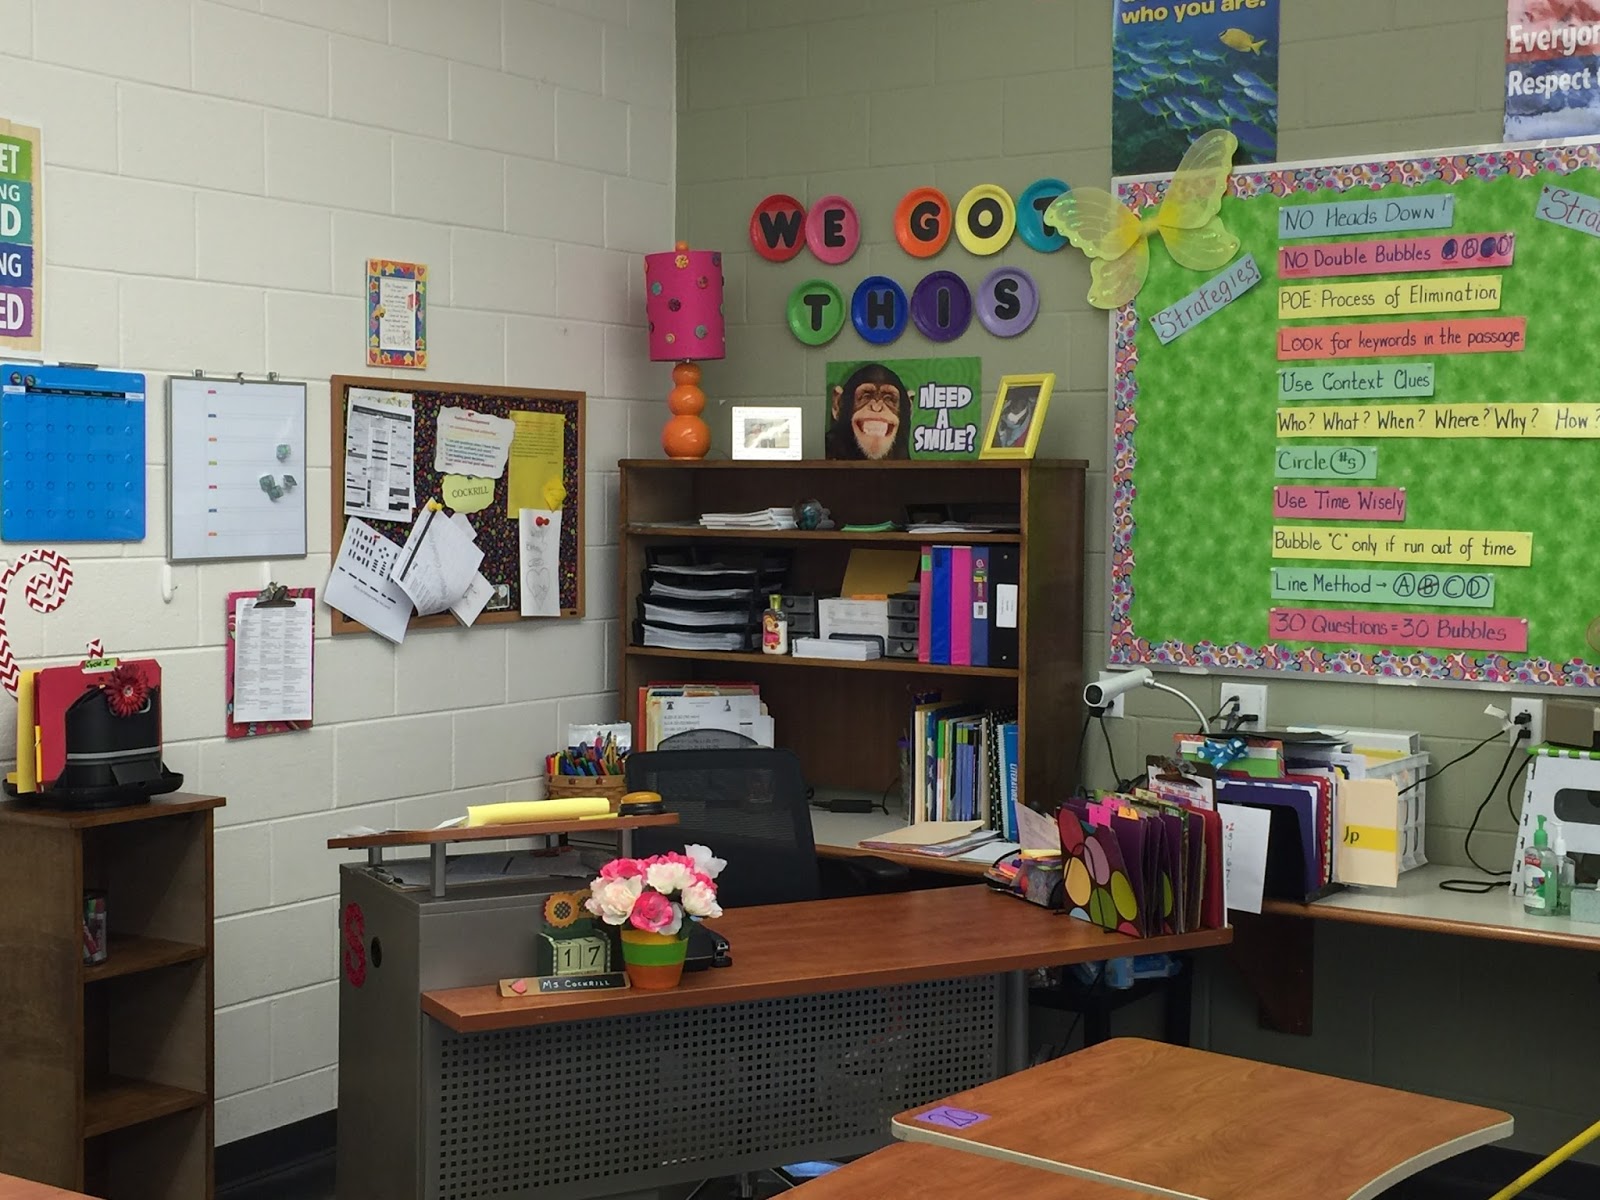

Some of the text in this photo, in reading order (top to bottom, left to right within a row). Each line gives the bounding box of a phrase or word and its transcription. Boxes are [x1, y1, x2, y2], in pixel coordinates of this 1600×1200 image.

[1121, 6, 1168, 24] who
[1173, 0, 1215, 23] you
[1508, 67, 1591, 100] Respect
[0, 203, 22, 237] D
[758, 208, 846, 250] WE
[1285, 209, 1314, 231] NO
[1326, 204, 1377, 228] Heads
[1284, 250, 1308, 269] NO
[1314, 244, 1368, 268] Double
[1375, 242, 1432, 264] Bubbles
[802, 277, 1021, 332] THIS
[1158, 259, 1256, 339] Strategies
[1321, 289, 1375, 309] Process
[1385, 285, 1401, 308] of
[1409, 282, 1498, 304] Elimination
[1329, 331, 1352, 356] for
[1358, 329, 1417, 352] keywords
[1424, 330, 1434, 346] in
[1439, 327, 1461, 345] the
[1282, 369, 1431, 393] Use Context Clues
[919, 382, 973, 409] NEED
[936, 408, 950, 430] A
[914, 424, 977, 453] SMILE?
[1278, 451, 1328, 471] Circle
[452, 485, 489, 499] COCKRILL
[1276, 489, 1404, 515] Use Time Wisely
[1275, 531, 1322, 550] Bubble
[1352, 533, 1377, 556] only
[1385, 533, 1395, 552] if
[1404, 541, 1424, 553] run
[1431, 536, 1452, 554] out
[1459, 538, 1474, 561] of
[1482, 537, 1516, 555] time
[1275, 573, 1308, 592] Line
[1314, 574, 1371, 593] Method
[1276, 613, 1306, 632] 30
[1312, 615, 1388, 636] Questions
[1400, 618, 1430, 638] 30
[1437, 620, 1507, 641] Bubbles
